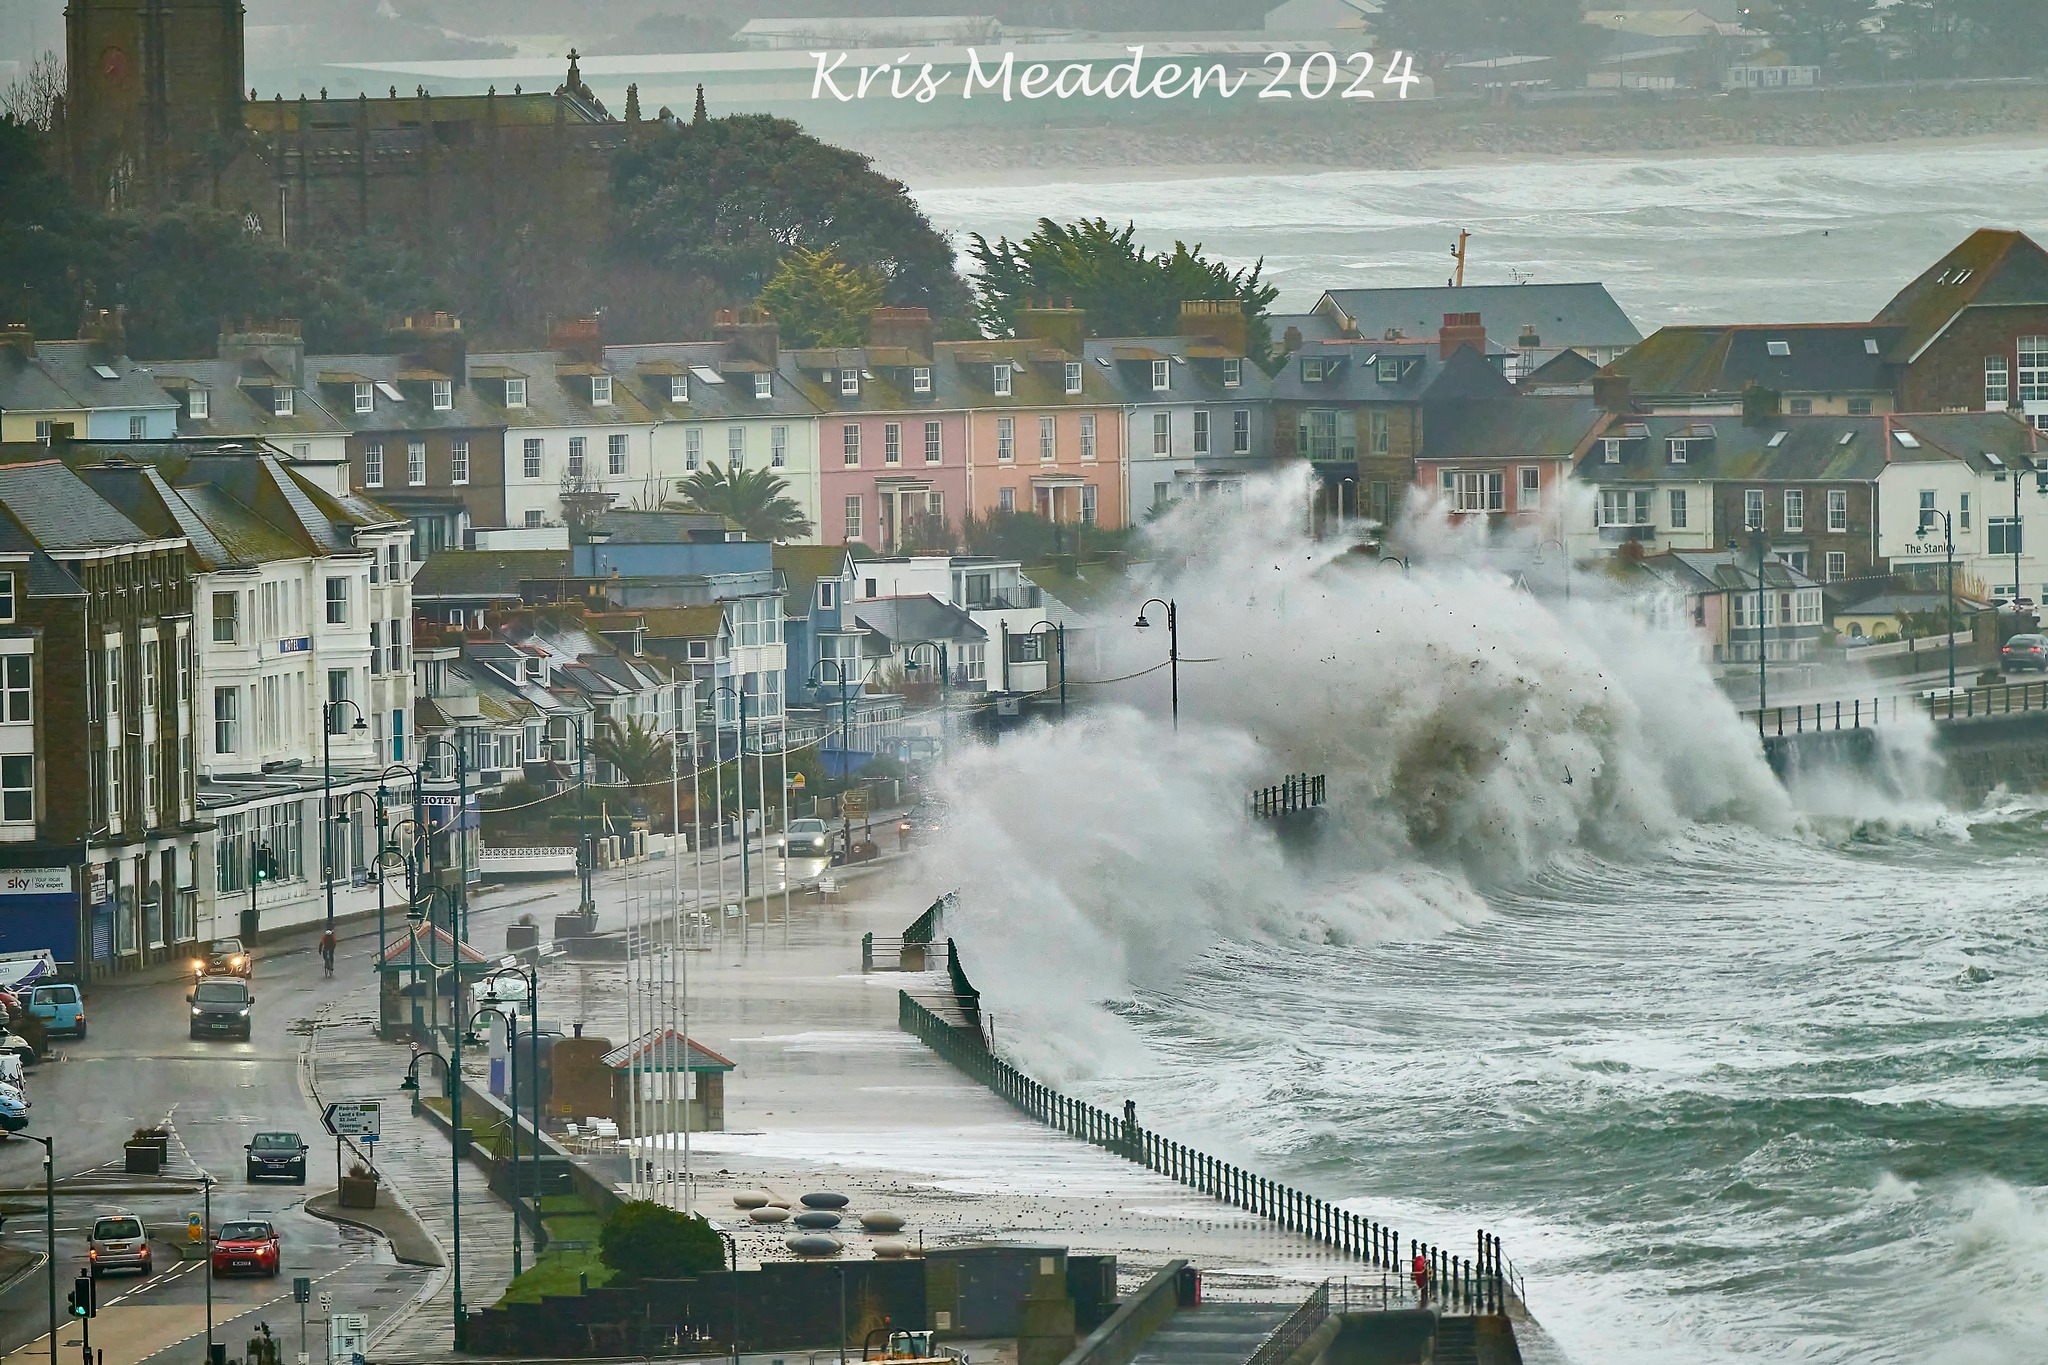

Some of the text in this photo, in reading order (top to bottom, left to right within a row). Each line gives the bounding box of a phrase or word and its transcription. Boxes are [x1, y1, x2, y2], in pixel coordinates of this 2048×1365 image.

[1905, 543, 1921, 554] The
[422, 796, 457, 805] HOTEL
[7, 876, 31, 891] sky
[0, 966, 10, 974] ach
